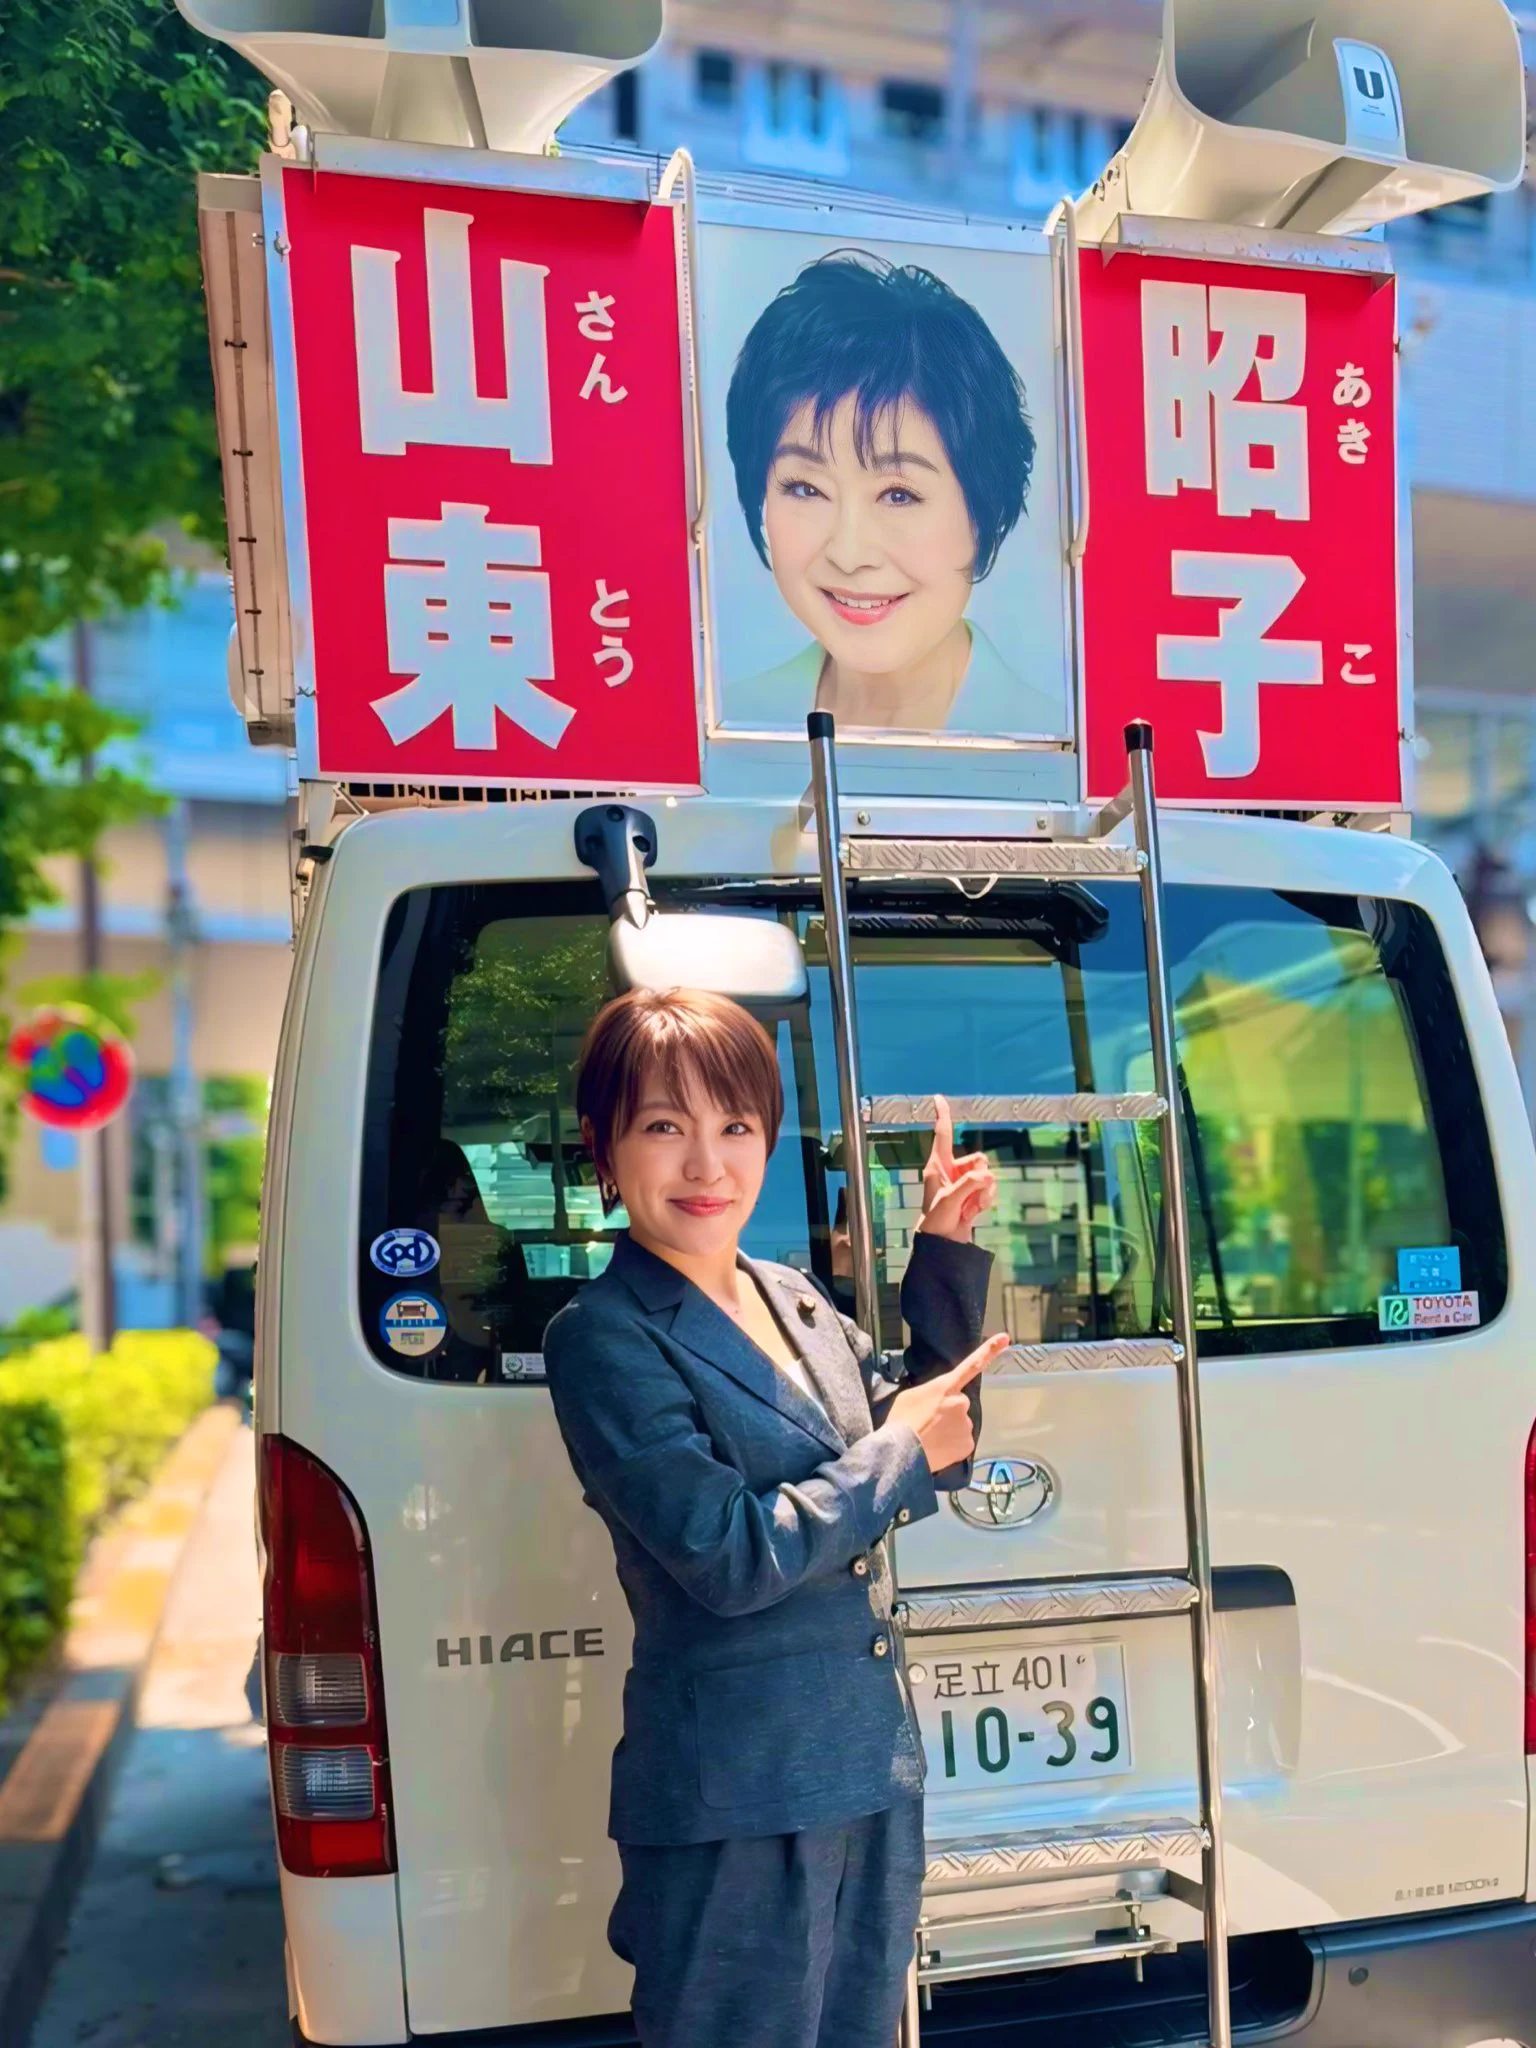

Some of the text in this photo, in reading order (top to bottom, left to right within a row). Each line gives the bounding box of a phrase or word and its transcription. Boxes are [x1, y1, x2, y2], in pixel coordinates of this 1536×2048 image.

[1353, 66, 1385, 100] U
[574, 290, 629, 404] さん
[1332, 362, 1372, 465] あき
[350, 207, 577, 750] 山東
[1141, 279, 1323, 779] 昭子
[590, 579, 634, 688] とう
[1340, 643, 1377, 686] こ
[1413, 1295, 1473, 1310] TOYOTA
[437, 1628, 605, 1668] HIACE
[934, 1654, 1067, 1699] 足立 401
[941, 1696, 1120, 1778] 10-39
